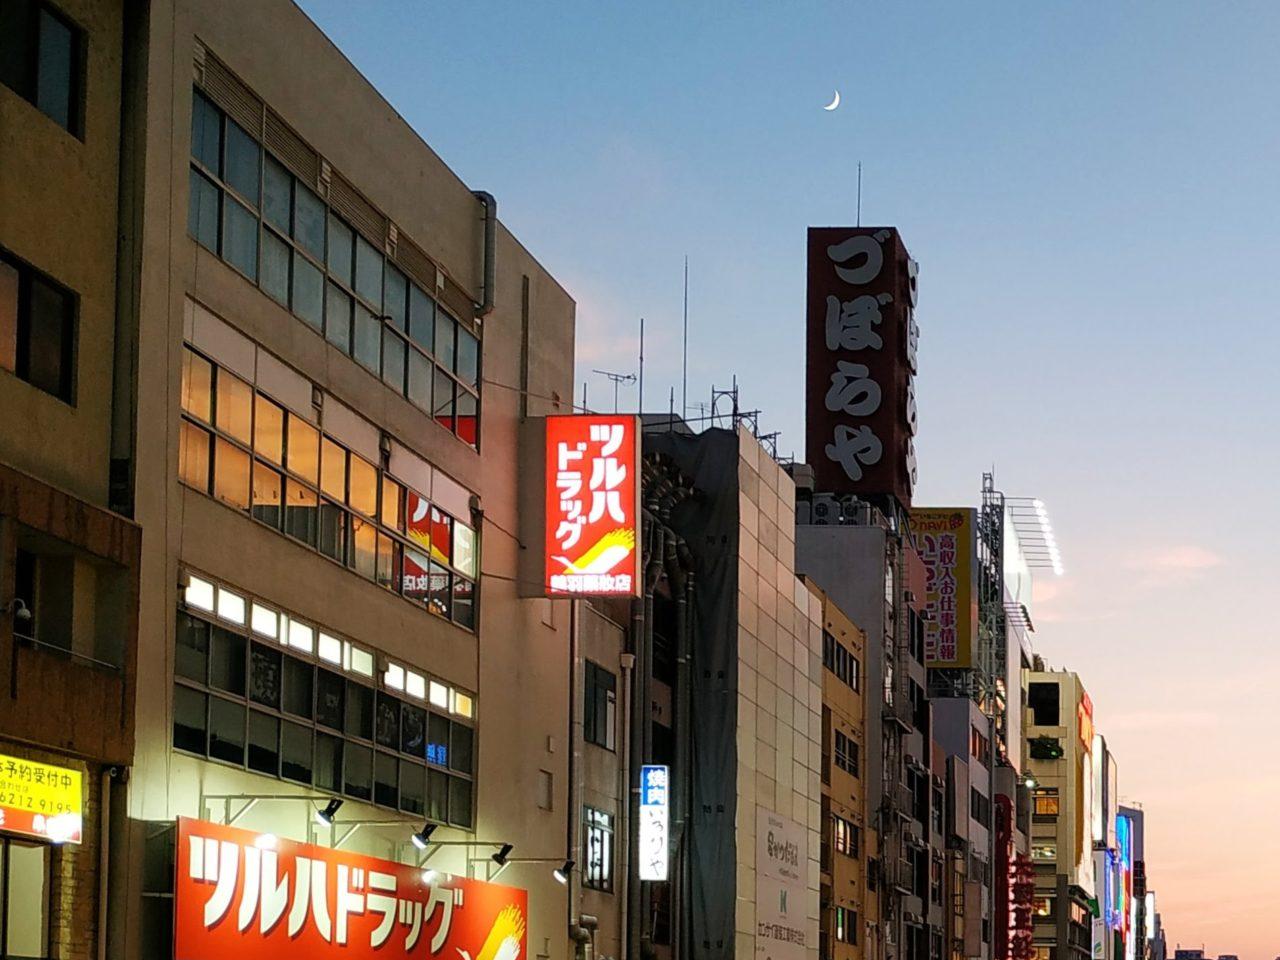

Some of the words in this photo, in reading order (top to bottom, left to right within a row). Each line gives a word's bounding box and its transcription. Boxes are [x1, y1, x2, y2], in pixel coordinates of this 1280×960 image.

[824, 229, 894, 482] づぼらや
[555, 441, 588, 551] ドラッグ
[588, 424, 627, 524] ツルハ
[189, 835, 464, 954] ツルハドラッグ
